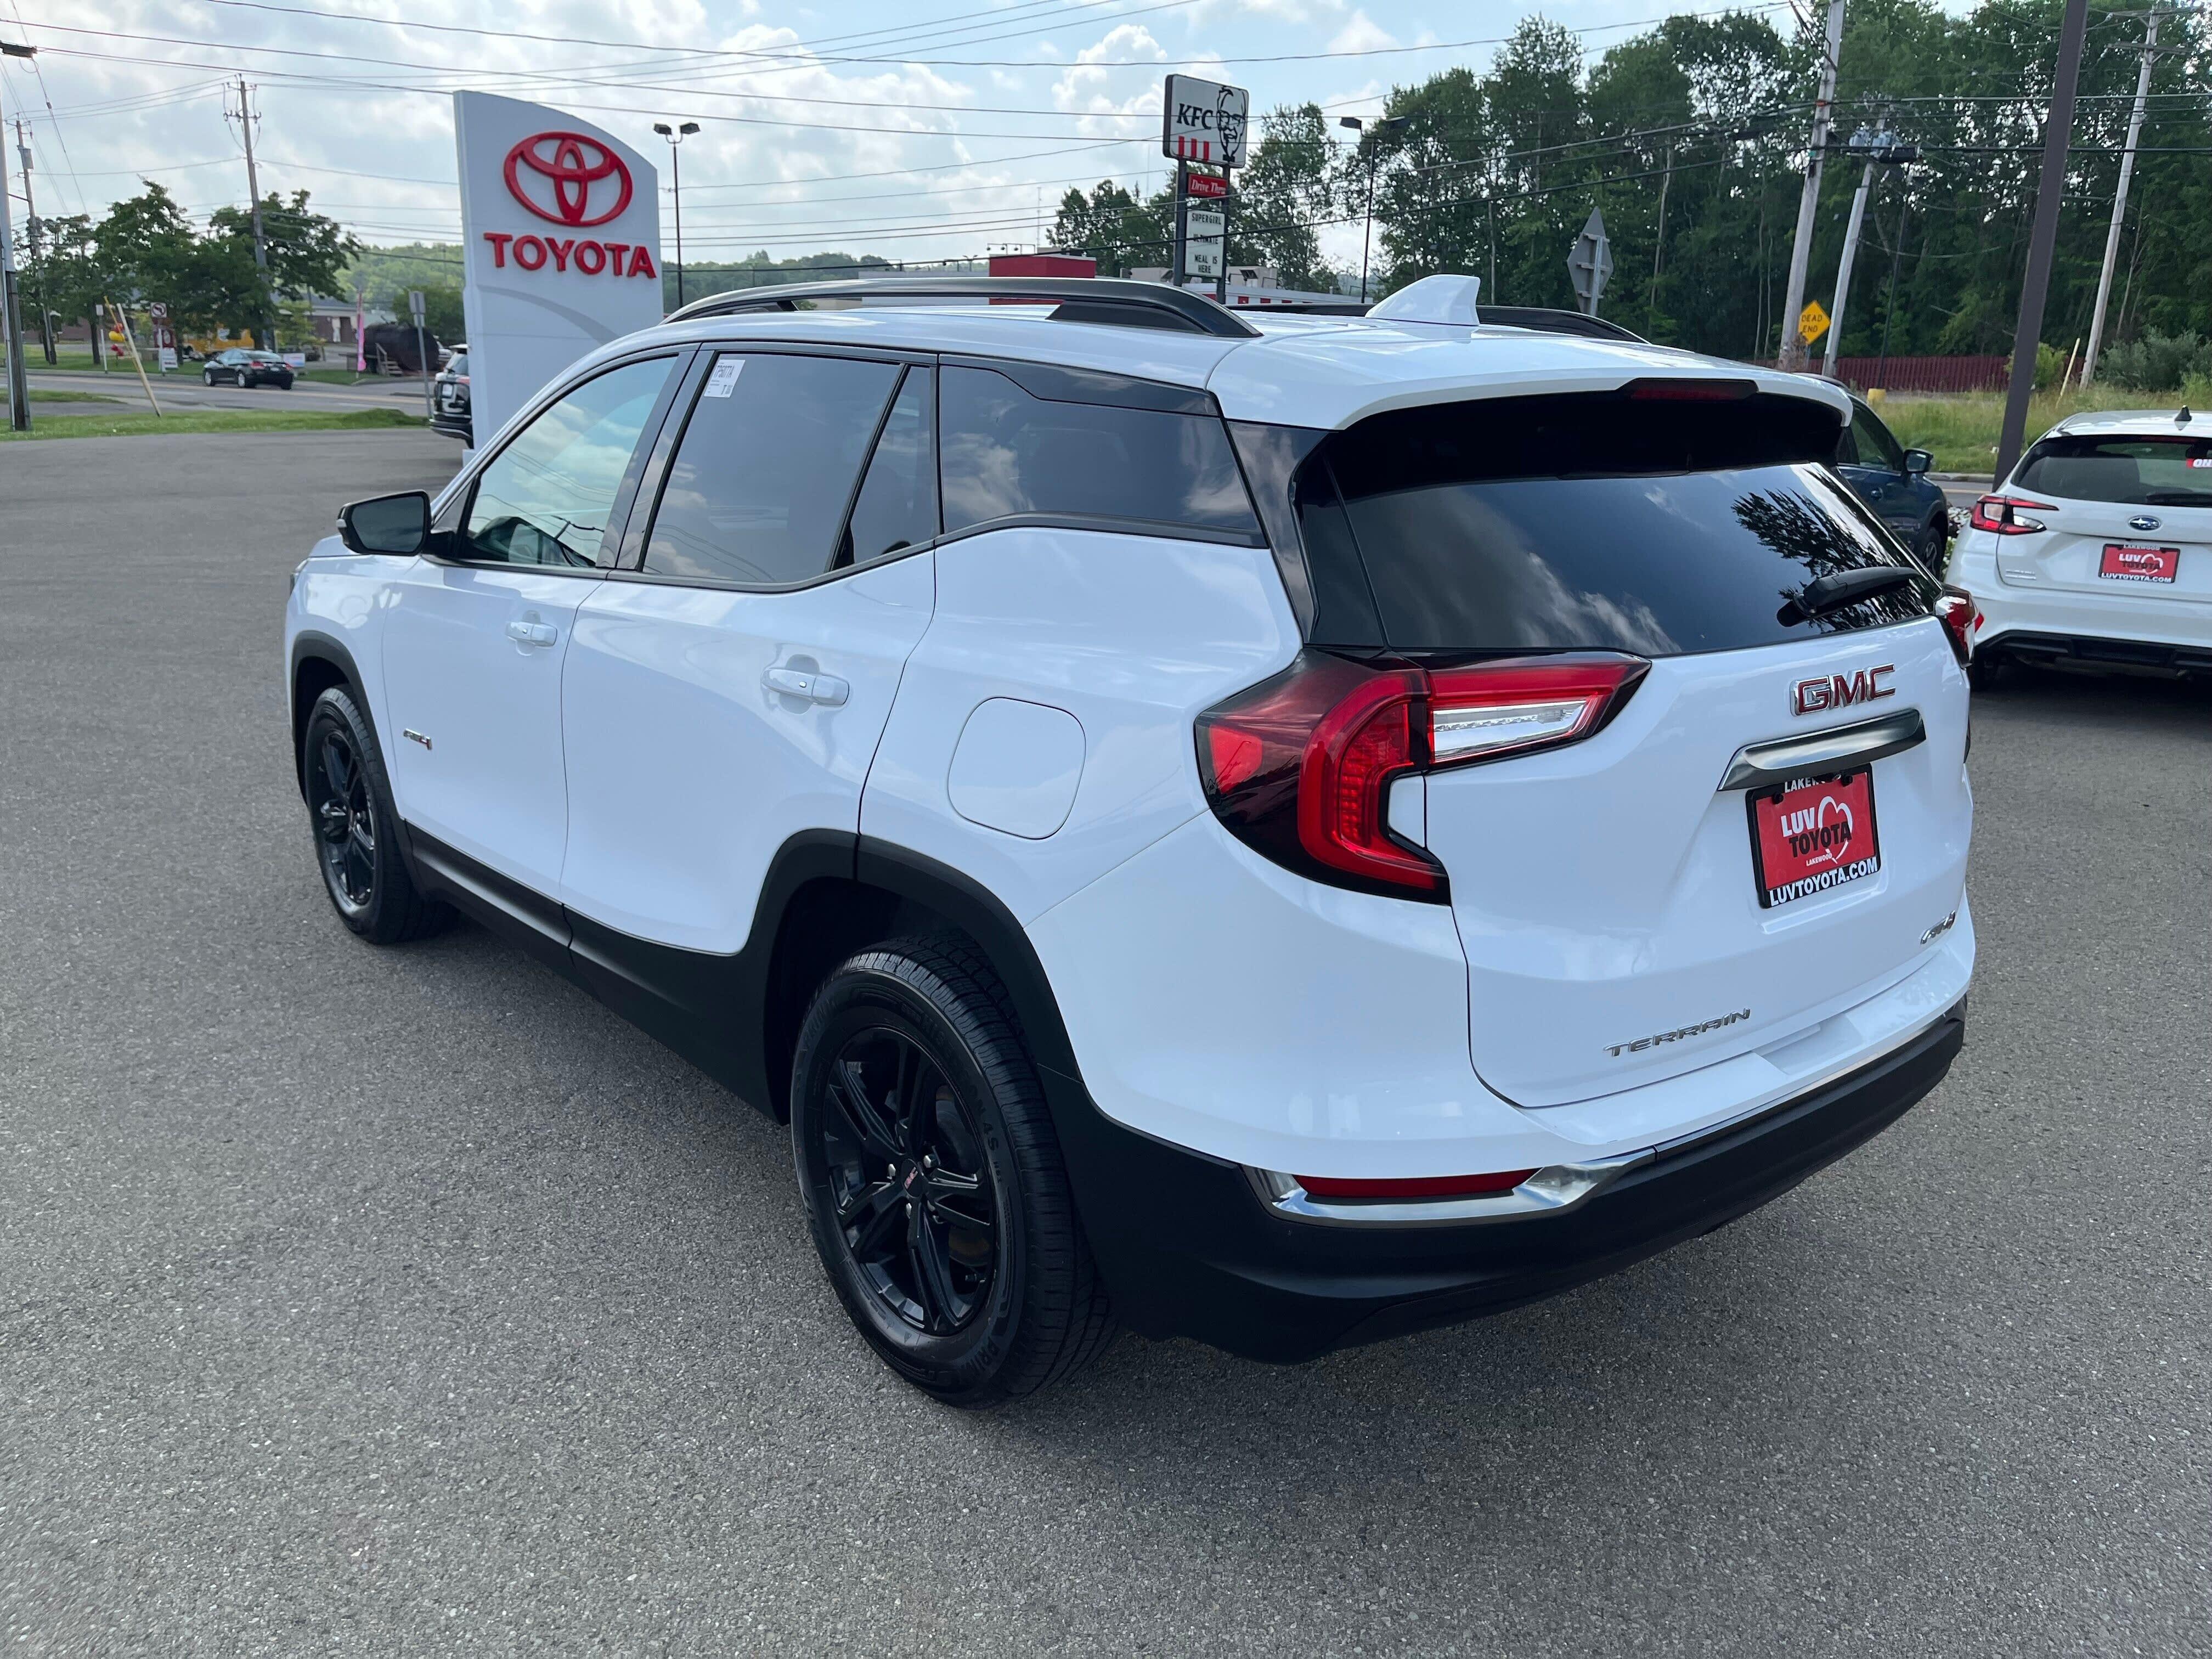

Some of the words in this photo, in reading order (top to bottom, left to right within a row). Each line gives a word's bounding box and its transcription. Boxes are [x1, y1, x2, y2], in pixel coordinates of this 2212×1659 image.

[1176, 103, 1213, 129] KFC
[1192, 179, 1209, 192] Drive
[1192, 213, 1221, 225] SUPERGIRL
[483, 233, 657, 278] TOYOTA
[1194, 254, 1208, 264] MEAL
[1212, 256, 1217, 264] IS
[1198, 264, 1211, 274] HERE
[1801, 314, 1822, 322] DEAD
[1802, 325, 1818, 333] END
[2119, 553, 2141, 562] LUV
[2123, 561, 2160, 571] TOYOTA
[2102, 572, 2172, 583] LUVTOYOTA.COM
[1790, 663, 1896, 716] GMC
[1781, 807, 1815, 837] LUV
[1789, 821, 1852, 857] TOYOTA
[1806, 853, 1832, 866] LAKEWOOD
[1769, 856, 1878, 907] LUVTOYOTA.COM
[1603, 1007, 1751, 1057] TERRAIN
